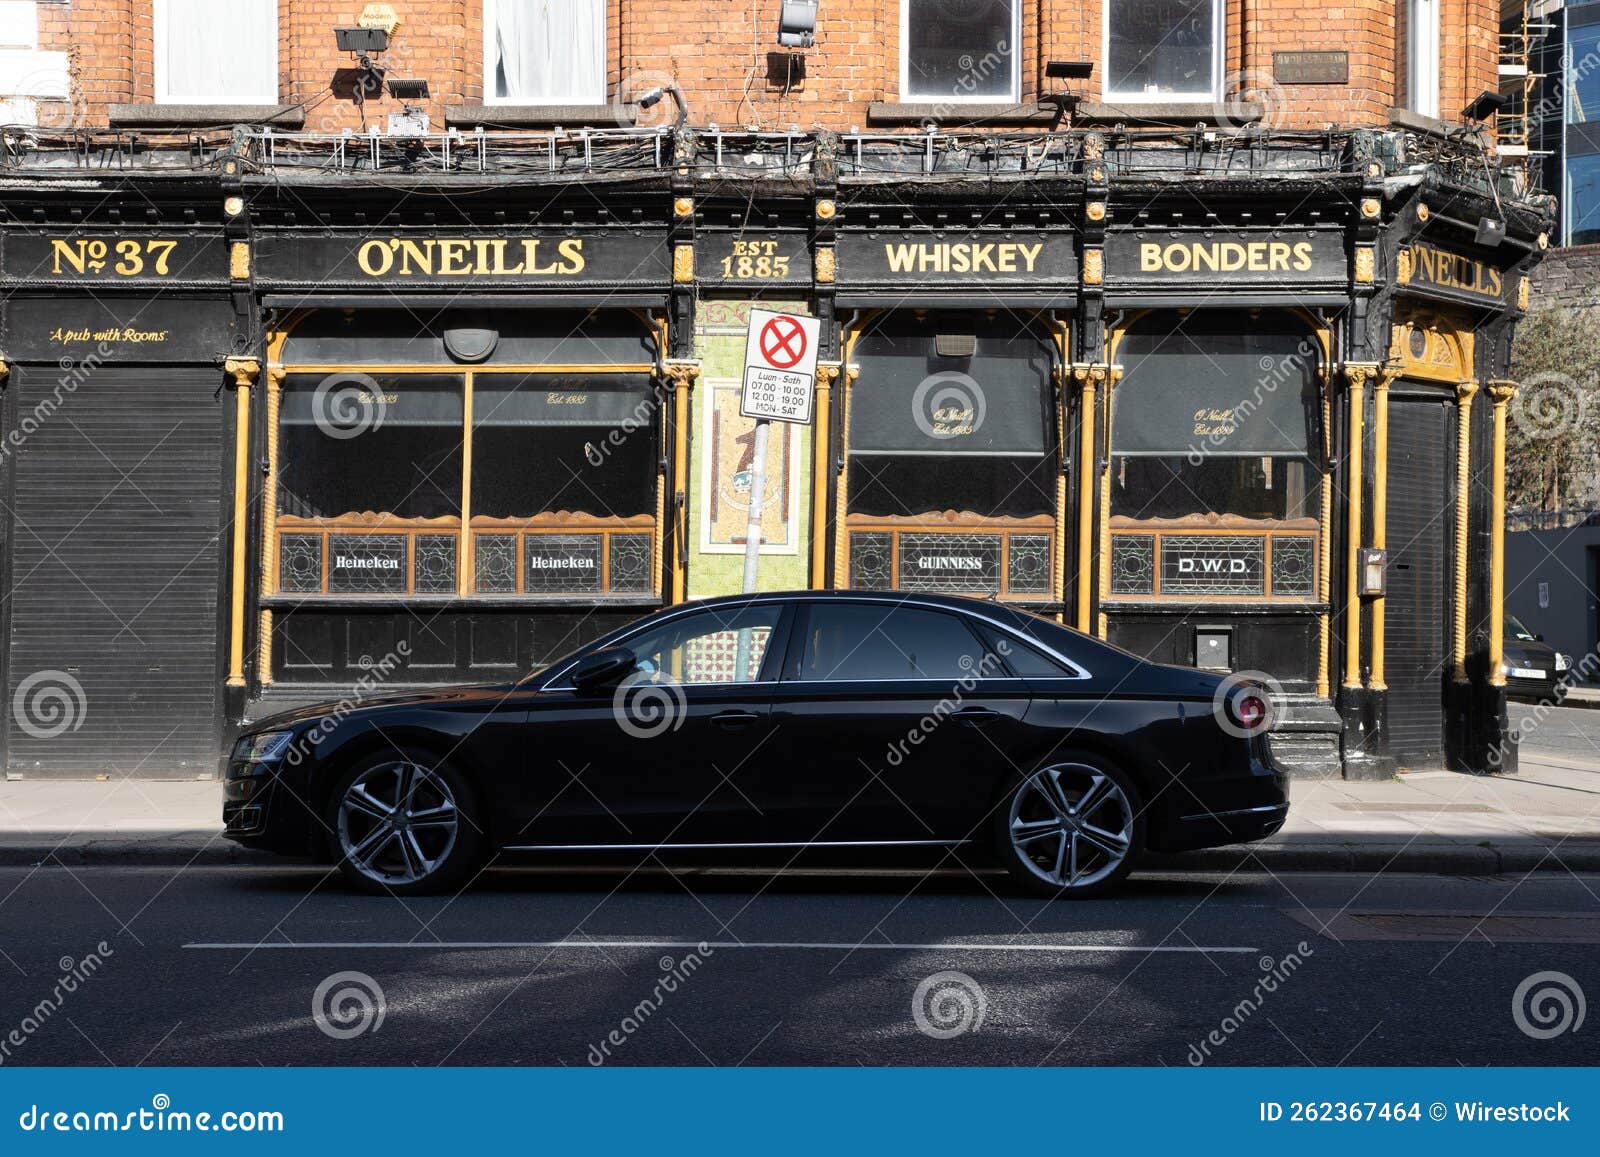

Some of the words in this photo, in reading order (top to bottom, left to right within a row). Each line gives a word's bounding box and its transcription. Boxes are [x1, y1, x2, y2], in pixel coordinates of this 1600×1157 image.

[732, 241, 778, 256] EST
[115, 240, 178, 276] 37
[357, 238, 586, 276] O'NEILLS
[885, 244, 1044, 273] WHISKEY
[1140, 242, 1313, 273] BONDERS
[721, 256, 790, 278] 1885
[63, 328, 90, 345] pub
[93, 328, 121, 342] with
[758, 372, 777, 381] Luan
[782, 375, 801, 384] Sath
[751, 381, 776, 392] 07.00
[783, 386, 806, 396] 10.00
[751, 392, 775, 402] 12.00
[781, 396, 804, 406] 19.00
[755, 403, 776, 412] MON
[781, 406, 797, 415] SAT
[336, 556, 399, 569] Heineken
[532, 556, 594, 569] Heineken
[918, 556, 983, 569] GUINNESS
